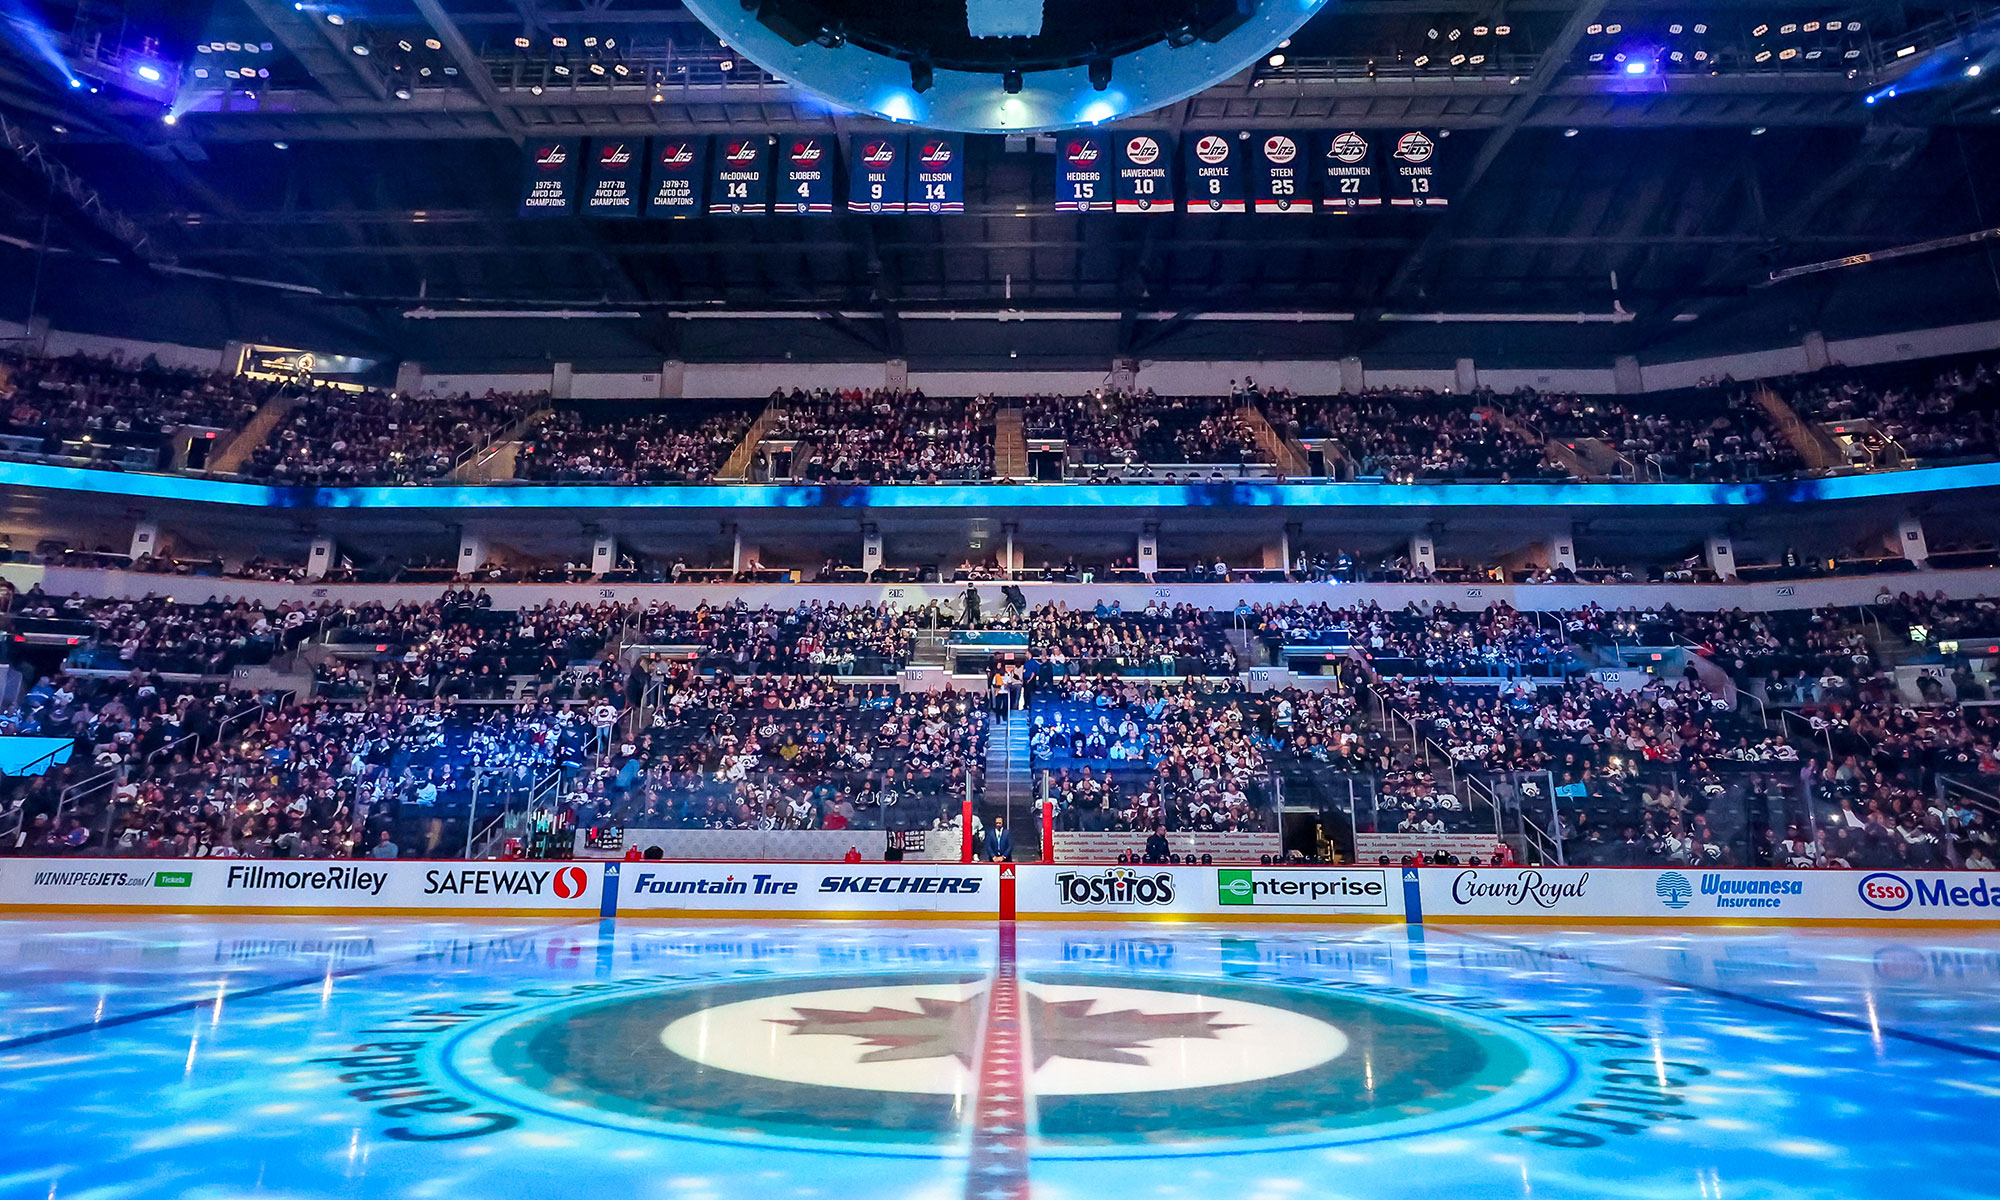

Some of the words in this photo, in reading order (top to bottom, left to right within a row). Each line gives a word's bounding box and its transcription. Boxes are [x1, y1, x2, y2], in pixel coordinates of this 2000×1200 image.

[720, 172, 759, 181] McDONALD
[789, 171, 820, 180] SJOBERG
[869, 173, 886, 182] HULL
[920, 173, 952, 182] NILSSON
[1066, 172, 1100, 181] HEDBERG
[1121, 169, 1165, 178] HAWERCHUK
[1198, 167, 1229, 176] CARLYLE
[1270, 168, 1294, 177] STEEN
[1327, 167, 1371, 176] NUMMINEN
[1399, 167, 1432, 176] SELANNE
[598, 180, 625, 189] 1977-78
[727, 182, 748, 197] 14
[797, 182, 810, 197] 4
[871, 184, 882, 199] 9
[925, 184, 946, 199] 14
[1073, 183, 1094, 199] 15
[1134, 179, 1154, 194] 10
[1209, 179, 1220, 194] 8
[1271, 179, 1294, 194] 25
[1340, 178, 1360, 193] 27
[1411, 178, 1429, 193] 13
[531, 190, 549, 198] AVCO
[595, 189, 612, 197] AVCO
[613, 189, 626, 197] CUP
[659, 189, 676, 197] AVCO
[525, 198, 566, 207] CHAMPIONS
[590, 197, 630, 206] CHAMPIONS
[653, 197, 693, 206] CHAMPIONS
[889, 588, 904, 598] 218
[1155, 588, 1170, 598] 219
[233, 669, 248, 678] 116
[906, 671, 923, 680] 118
[1251, 671, 1269, 681] 119
[1602, 671, 1620, 681] 120
[227, 866, 388, 895] FillmoreRiley
[424, 869, 550, 896] SAFEWAY
[634, 873, 748, 895] Fountain
[753, 873, 799, 896] Tire
[818, 876, 983, 895] SKECHERS
[1700, 873, 1803, 895] Wawanesa
[1229, 876, 1382, 901] enterprise
[1452, 869, 1520, 905] Crown
[1508, 869, 1590, 908] Royal
[1866, 882, 1906, 899] Esso
[1716, 895, 1781, 909] Insurance
[514, 968, 775, 998] Centre
[357, 1003, 520, 1033] Life
[1504, 1014, 1649, 1049] Life
[309, 1041, 520, 1141] Canada
[1500, 1059, 1711, 1148] Centre
